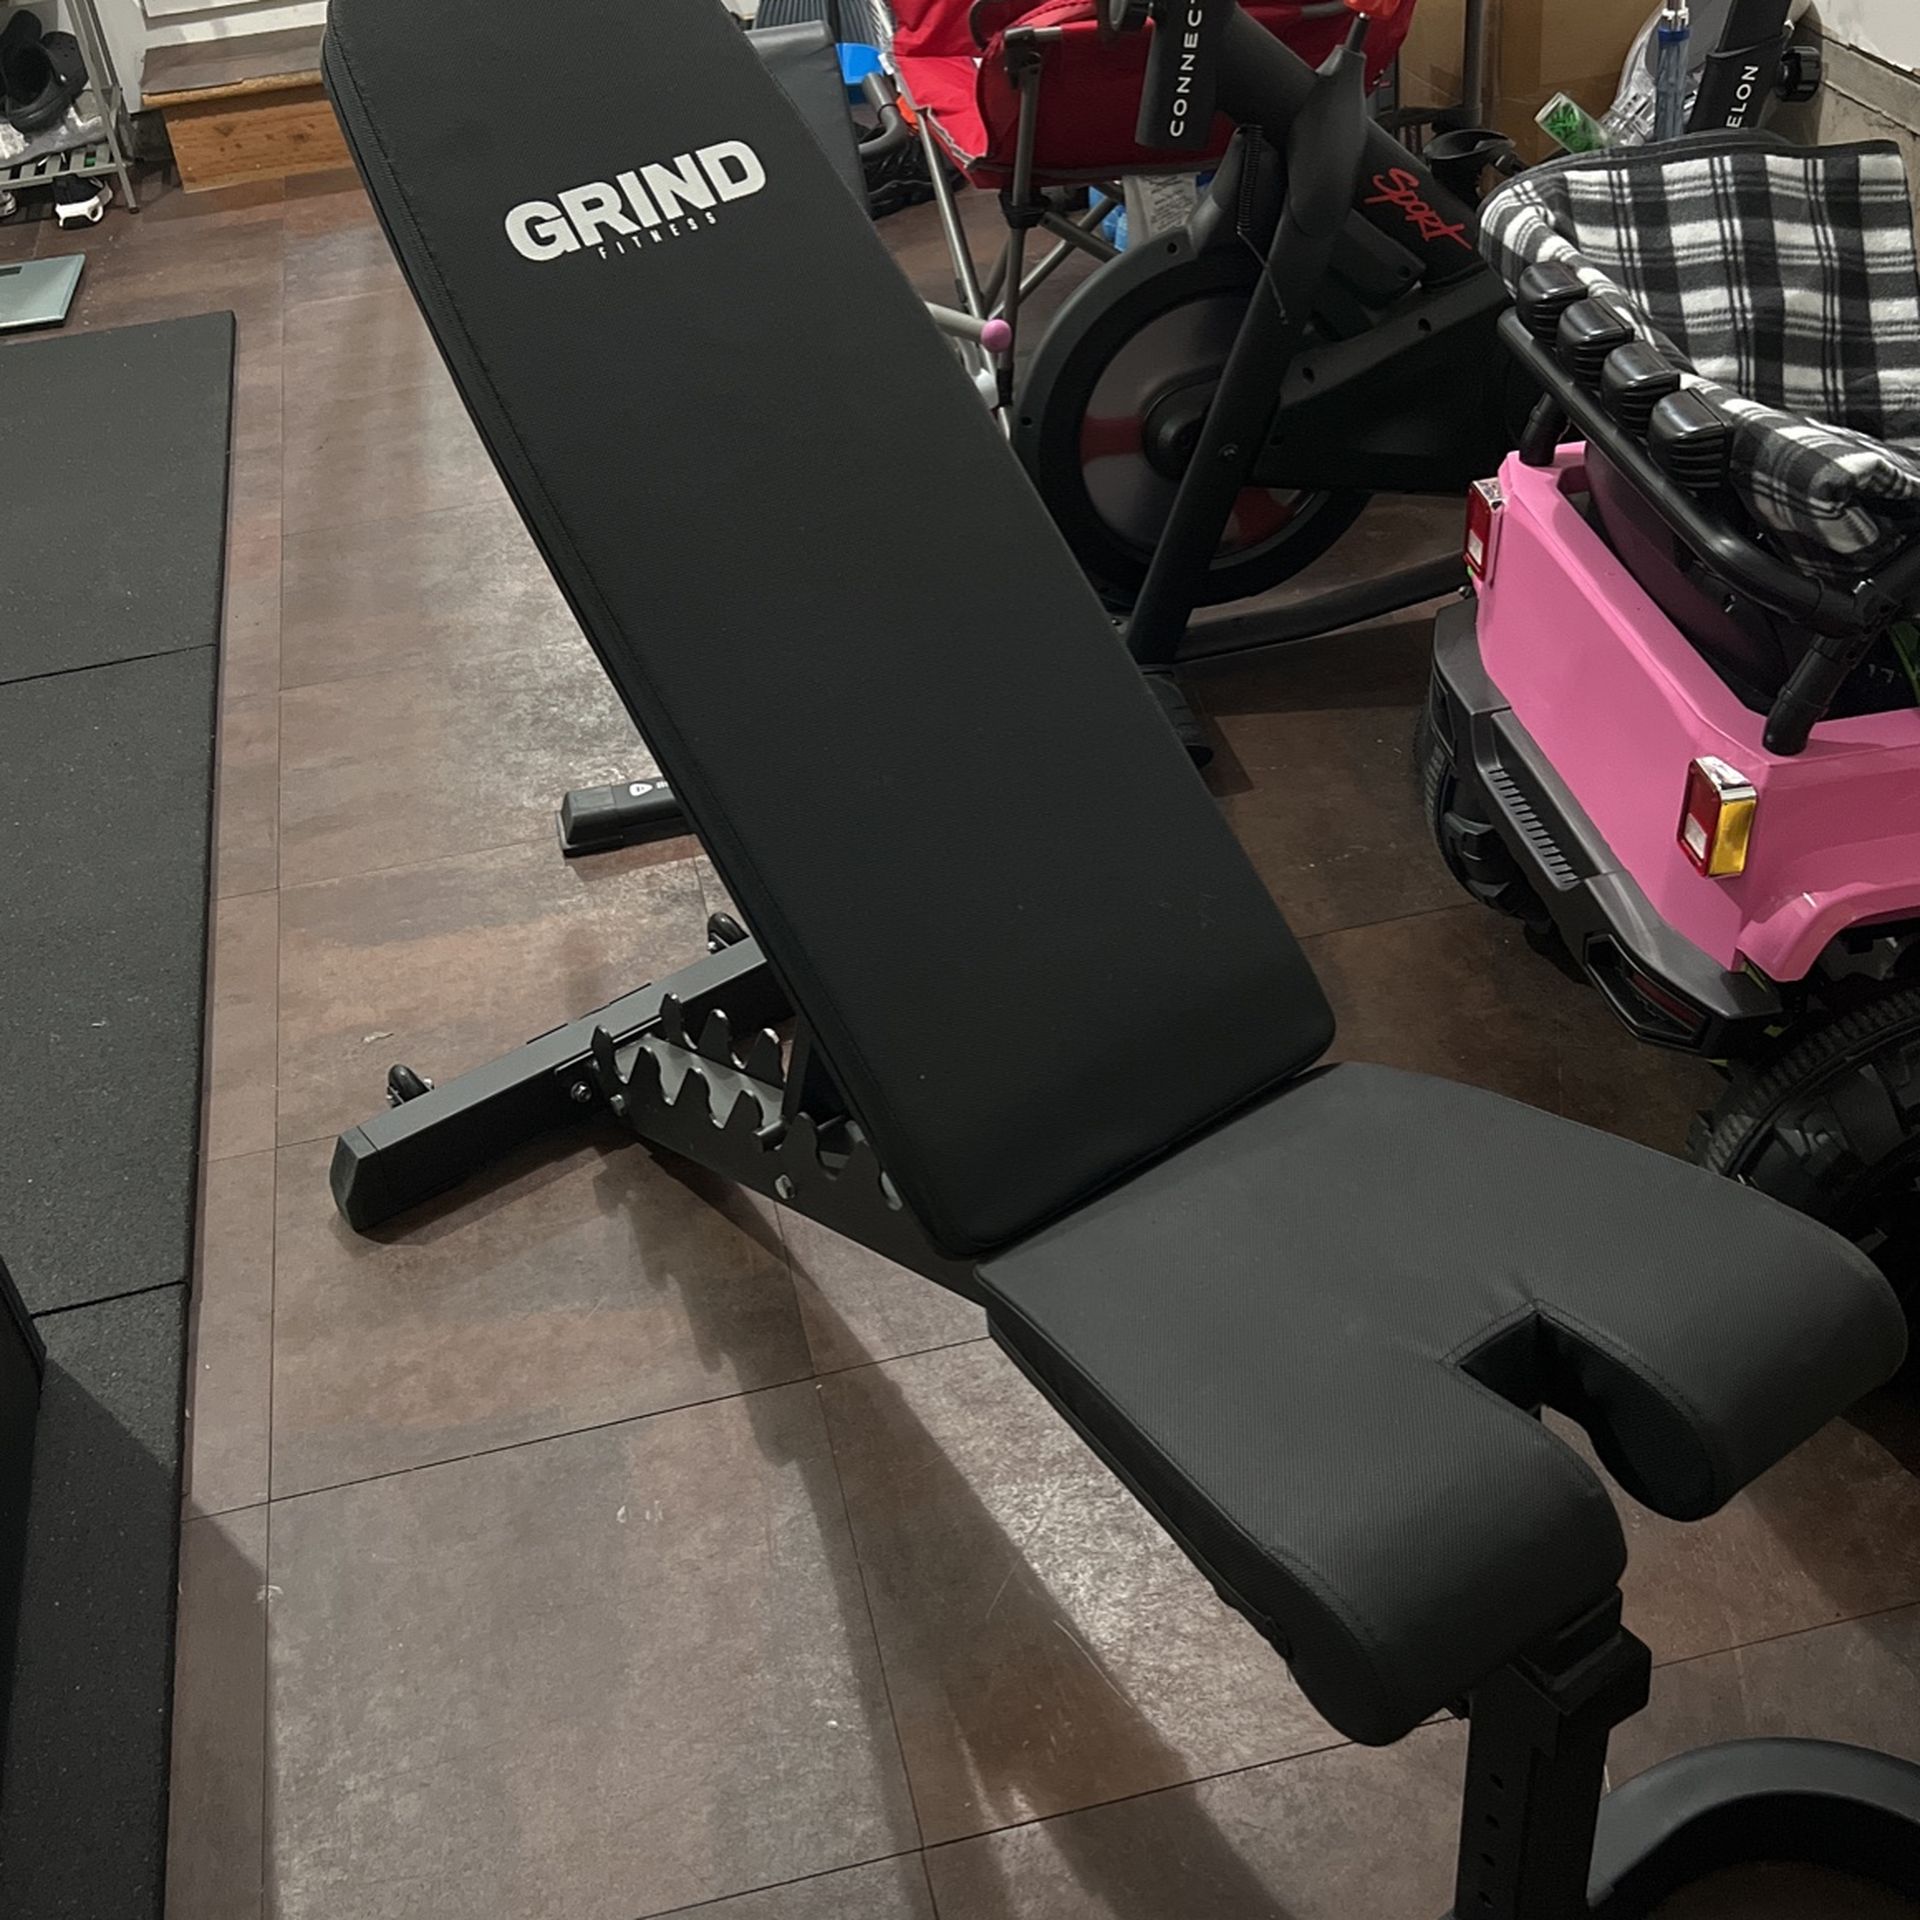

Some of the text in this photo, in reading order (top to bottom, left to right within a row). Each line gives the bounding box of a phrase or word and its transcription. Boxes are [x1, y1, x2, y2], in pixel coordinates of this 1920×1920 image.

[1170, 0, 1202, 137] CONNEC
[505, 140, 766, 261] GRIND
[599, 211, 716, 259] FITNESS
